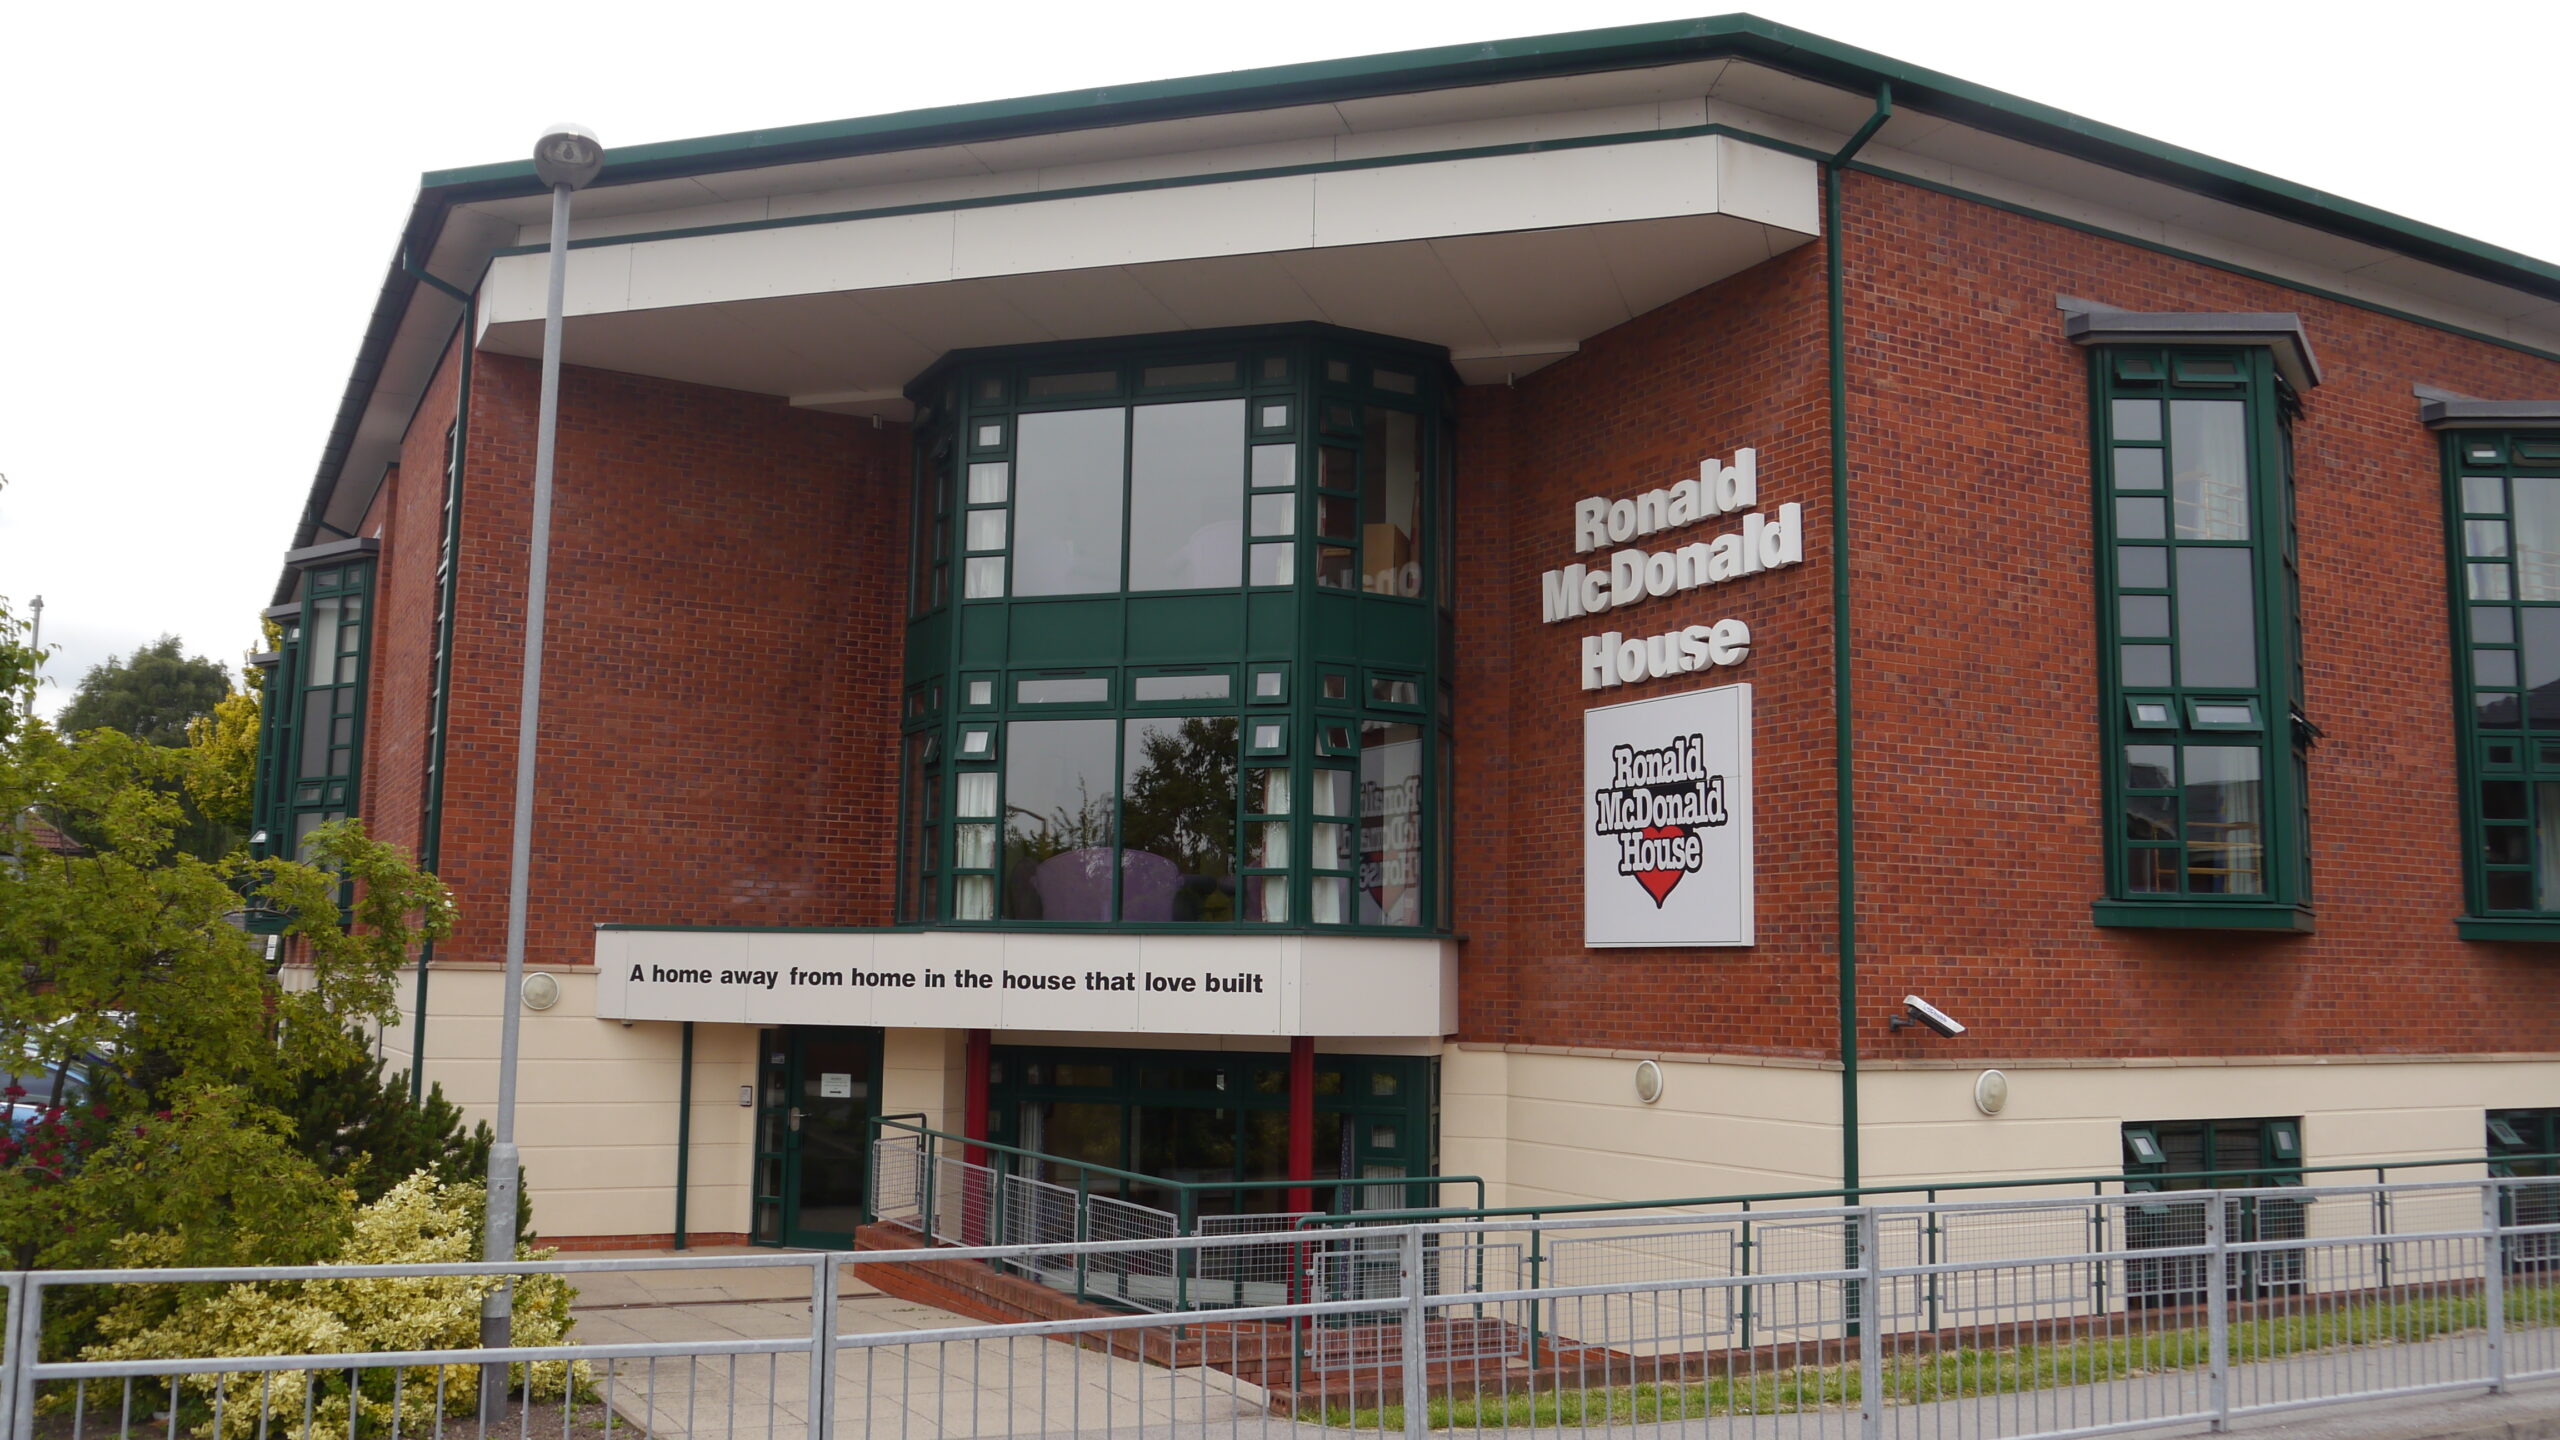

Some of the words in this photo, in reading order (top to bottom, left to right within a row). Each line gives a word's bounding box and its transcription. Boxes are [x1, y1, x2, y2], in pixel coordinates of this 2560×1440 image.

[1576, 448, 1757, 553] Ronald
[1542, 502, 1802, 623] McDonald
[1582, 618, 1751, 691] House
[1614, 736, 1705, 789] Ronald
[1597, 778, 1726, 832] McDonald
[1620, 831, 1701, 873] House
[630, 965, 645, 982] A
[652, 965, 713, 984] home
[720, 970, 779, 990] away
[789, 967, 843, 986] from
[851, 968, 916, 987] home
[924, 969, 946, 988] in
[954, 970, 993, 989] the
[1002, 970, 1076, 990] house
[1084, 972, 1136, 991] that
[1145, 973, 1197, 992] love
[1206, 973, 1263, 993] built
